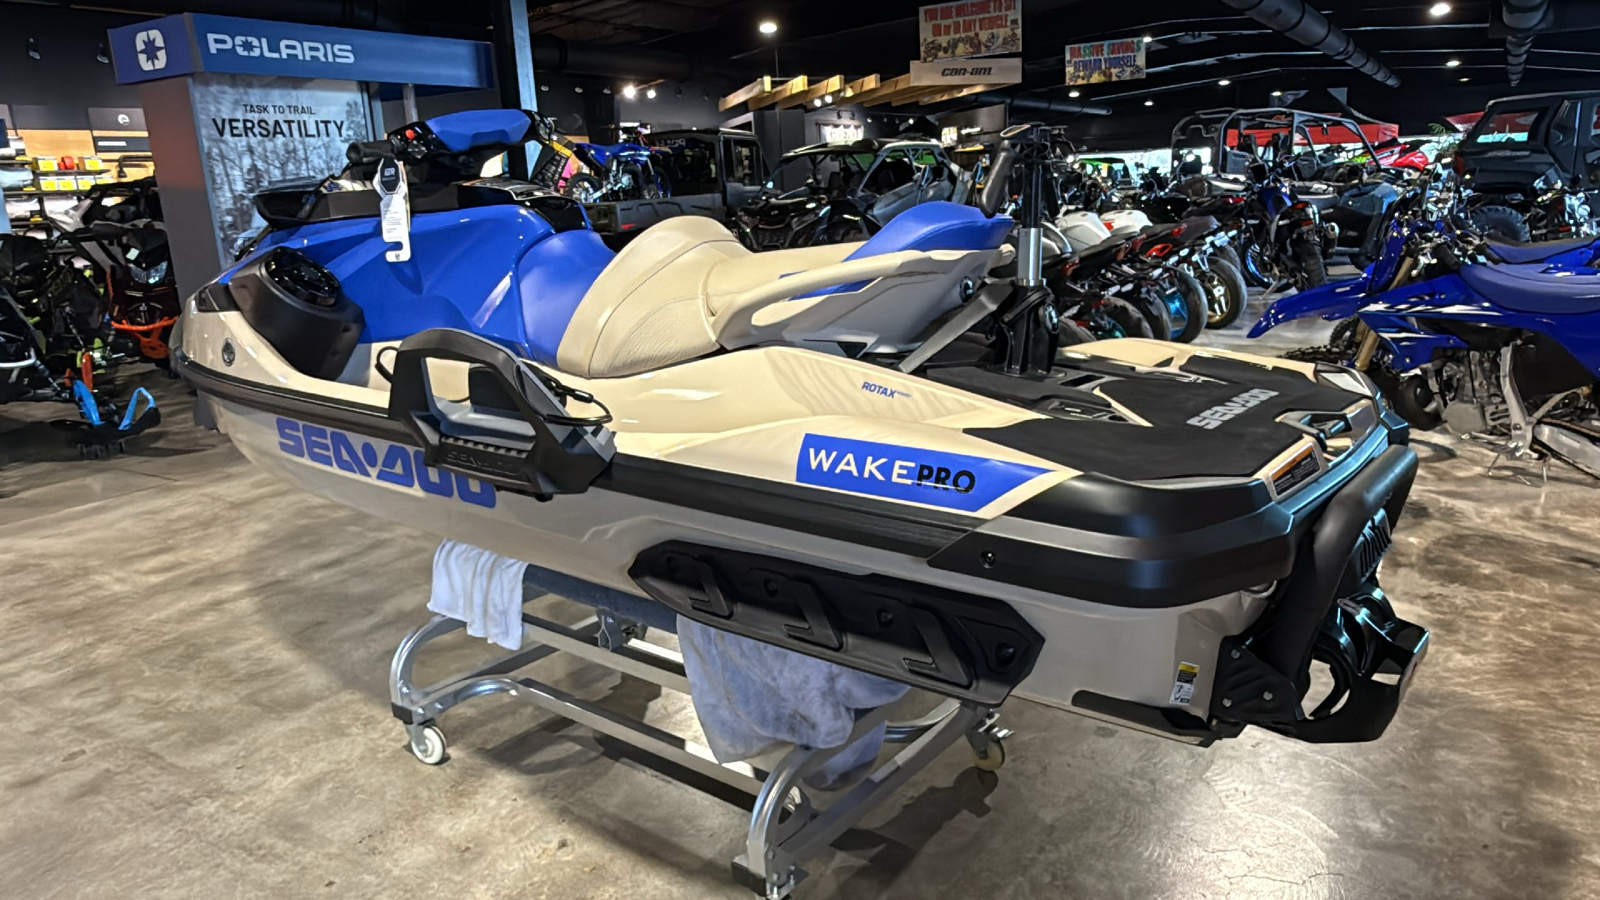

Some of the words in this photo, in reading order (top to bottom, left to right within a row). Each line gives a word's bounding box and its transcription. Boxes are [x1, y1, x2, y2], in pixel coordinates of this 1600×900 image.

[206, 33, 355, 64] POLARIS
[1069, 43, 1104, 60] MASSIVE
[1106, 39, 1142, 56] SAVINGS
[1104, 54, 1137, 69] YOURSELF
[243, 104, 270, 114] TASK
[273, 105, 285, 115] TO
[287, 105, 316, 115] TRAIL
[211, 118, 345, 138] VERSATILITY
[861, 381, 897, 398] ROTAX
